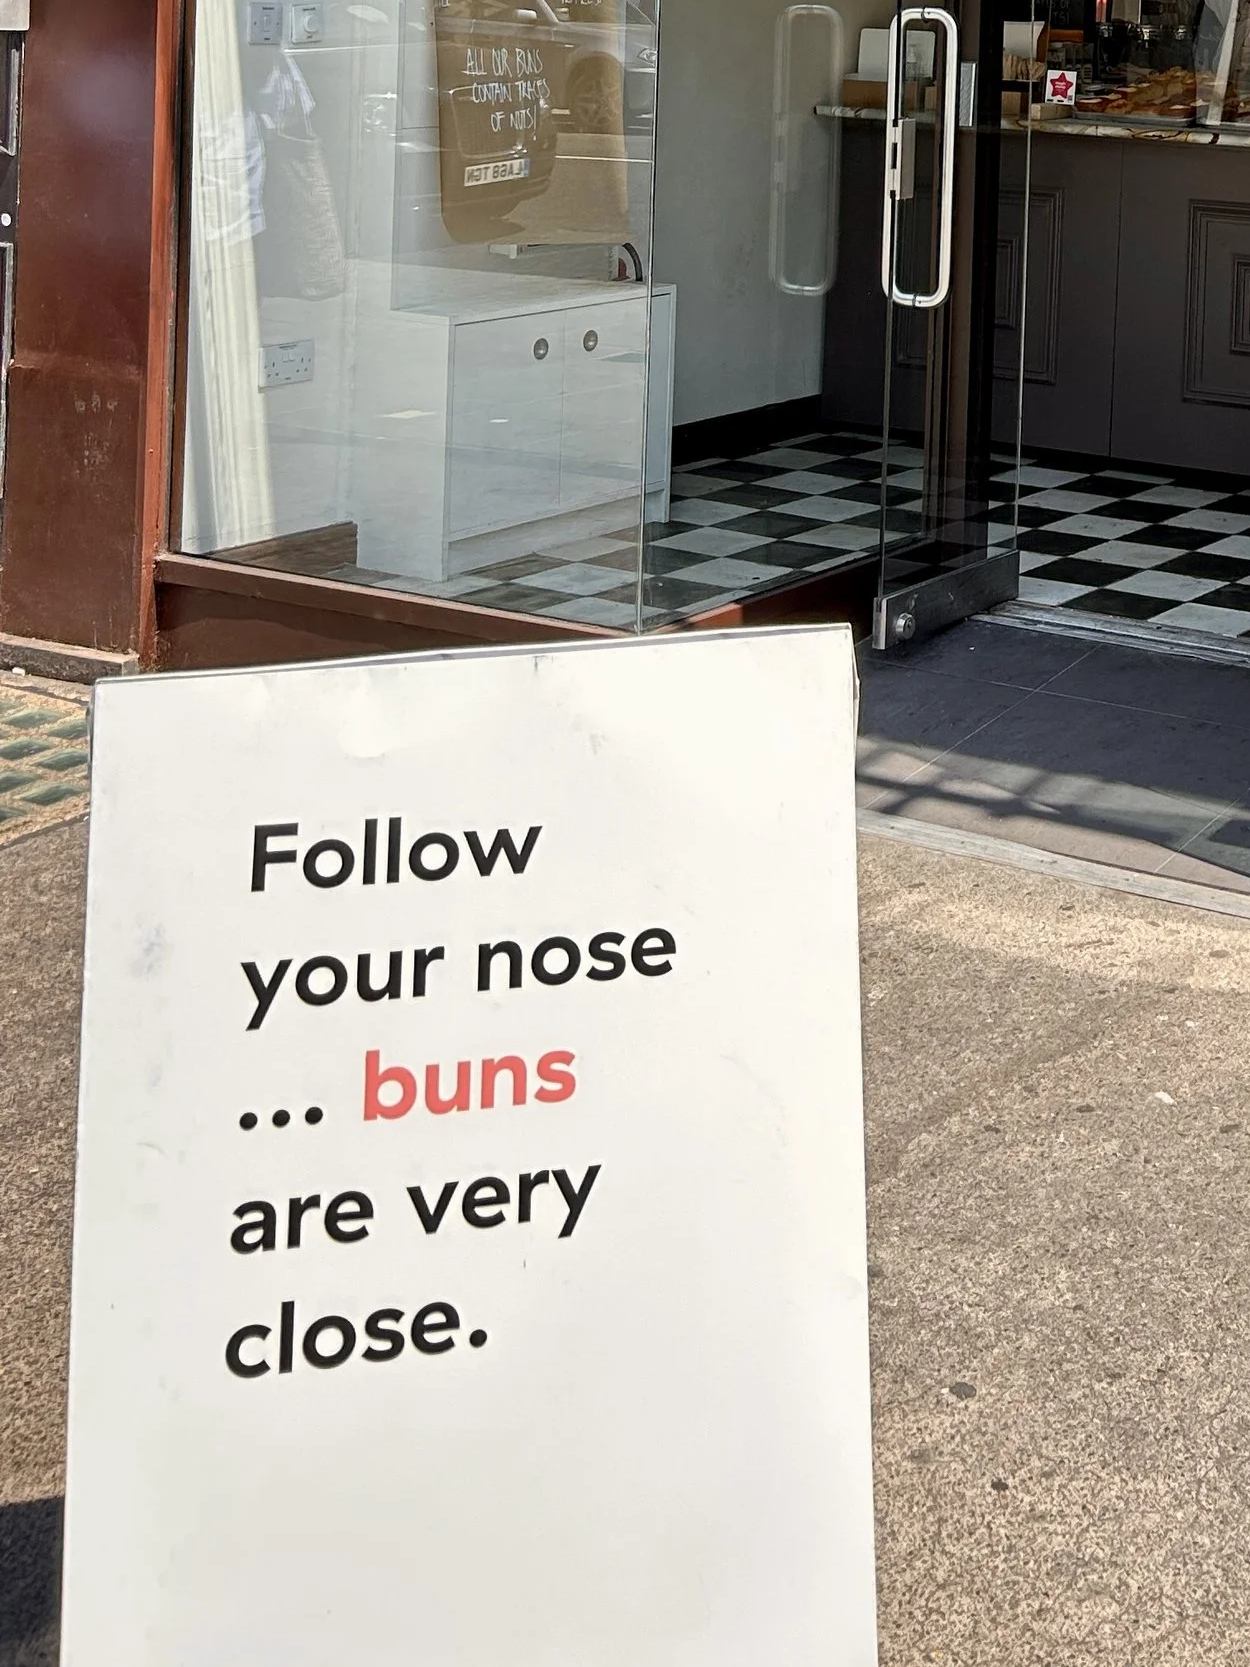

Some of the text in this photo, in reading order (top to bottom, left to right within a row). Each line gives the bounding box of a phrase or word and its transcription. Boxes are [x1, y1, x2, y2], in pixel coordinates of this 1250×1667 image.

[466, 48, 543, 77] ALL OUR BUNS
[472, 78, 550, 105] CONTAIN TRACES
[491, 111, 505, 133] OF
[250, 816, 543, 893] Follow
[240, 925, 677, 1031] your nose
[238, 1047, 577, 1131] ... buns
[229, 1164, 602, 1255] are very
[224, 1298, 488, 1380] close.
